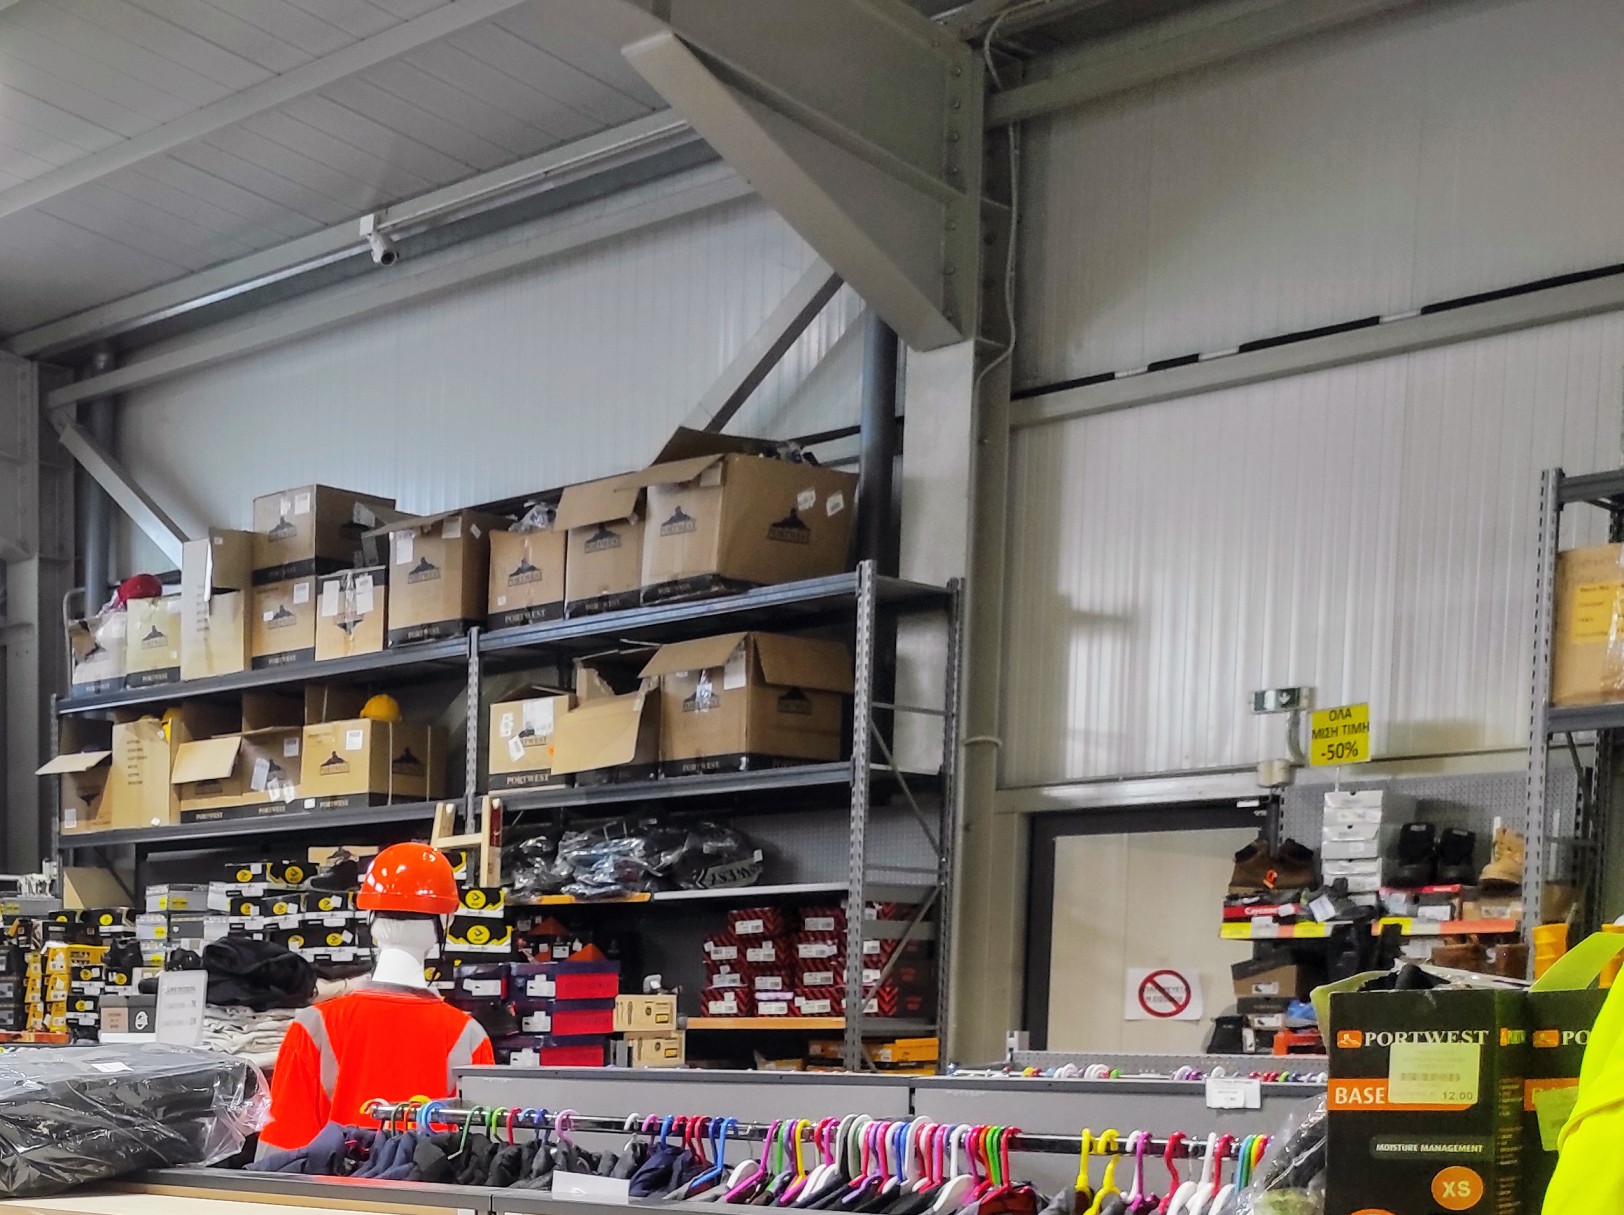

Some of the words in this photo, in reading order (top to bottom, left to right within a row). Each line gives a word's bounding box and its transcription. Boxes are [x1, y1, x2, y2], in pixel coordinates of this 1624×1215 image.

[1329, 708, 1352, 721] ΟΛΑ
[1312, 728, 1338, 739] ΜΙΣΗ
[1343, 721, 1369, 736] ΤΙΜΗ
[1321, 741, 1359, 760] -50%
[1364, 1030, 1489, 1047] PORTWEST
[1335, 1087, 1385, 1104] BASE
[1443, 1091, 1473, 1101] 12.00
[1376, 1144, 1418, 1152] MOISTURE
[1420, 1144, 1483, 1153] MANAGEMENT
[1442, 1181, 1471, 1198] XS
